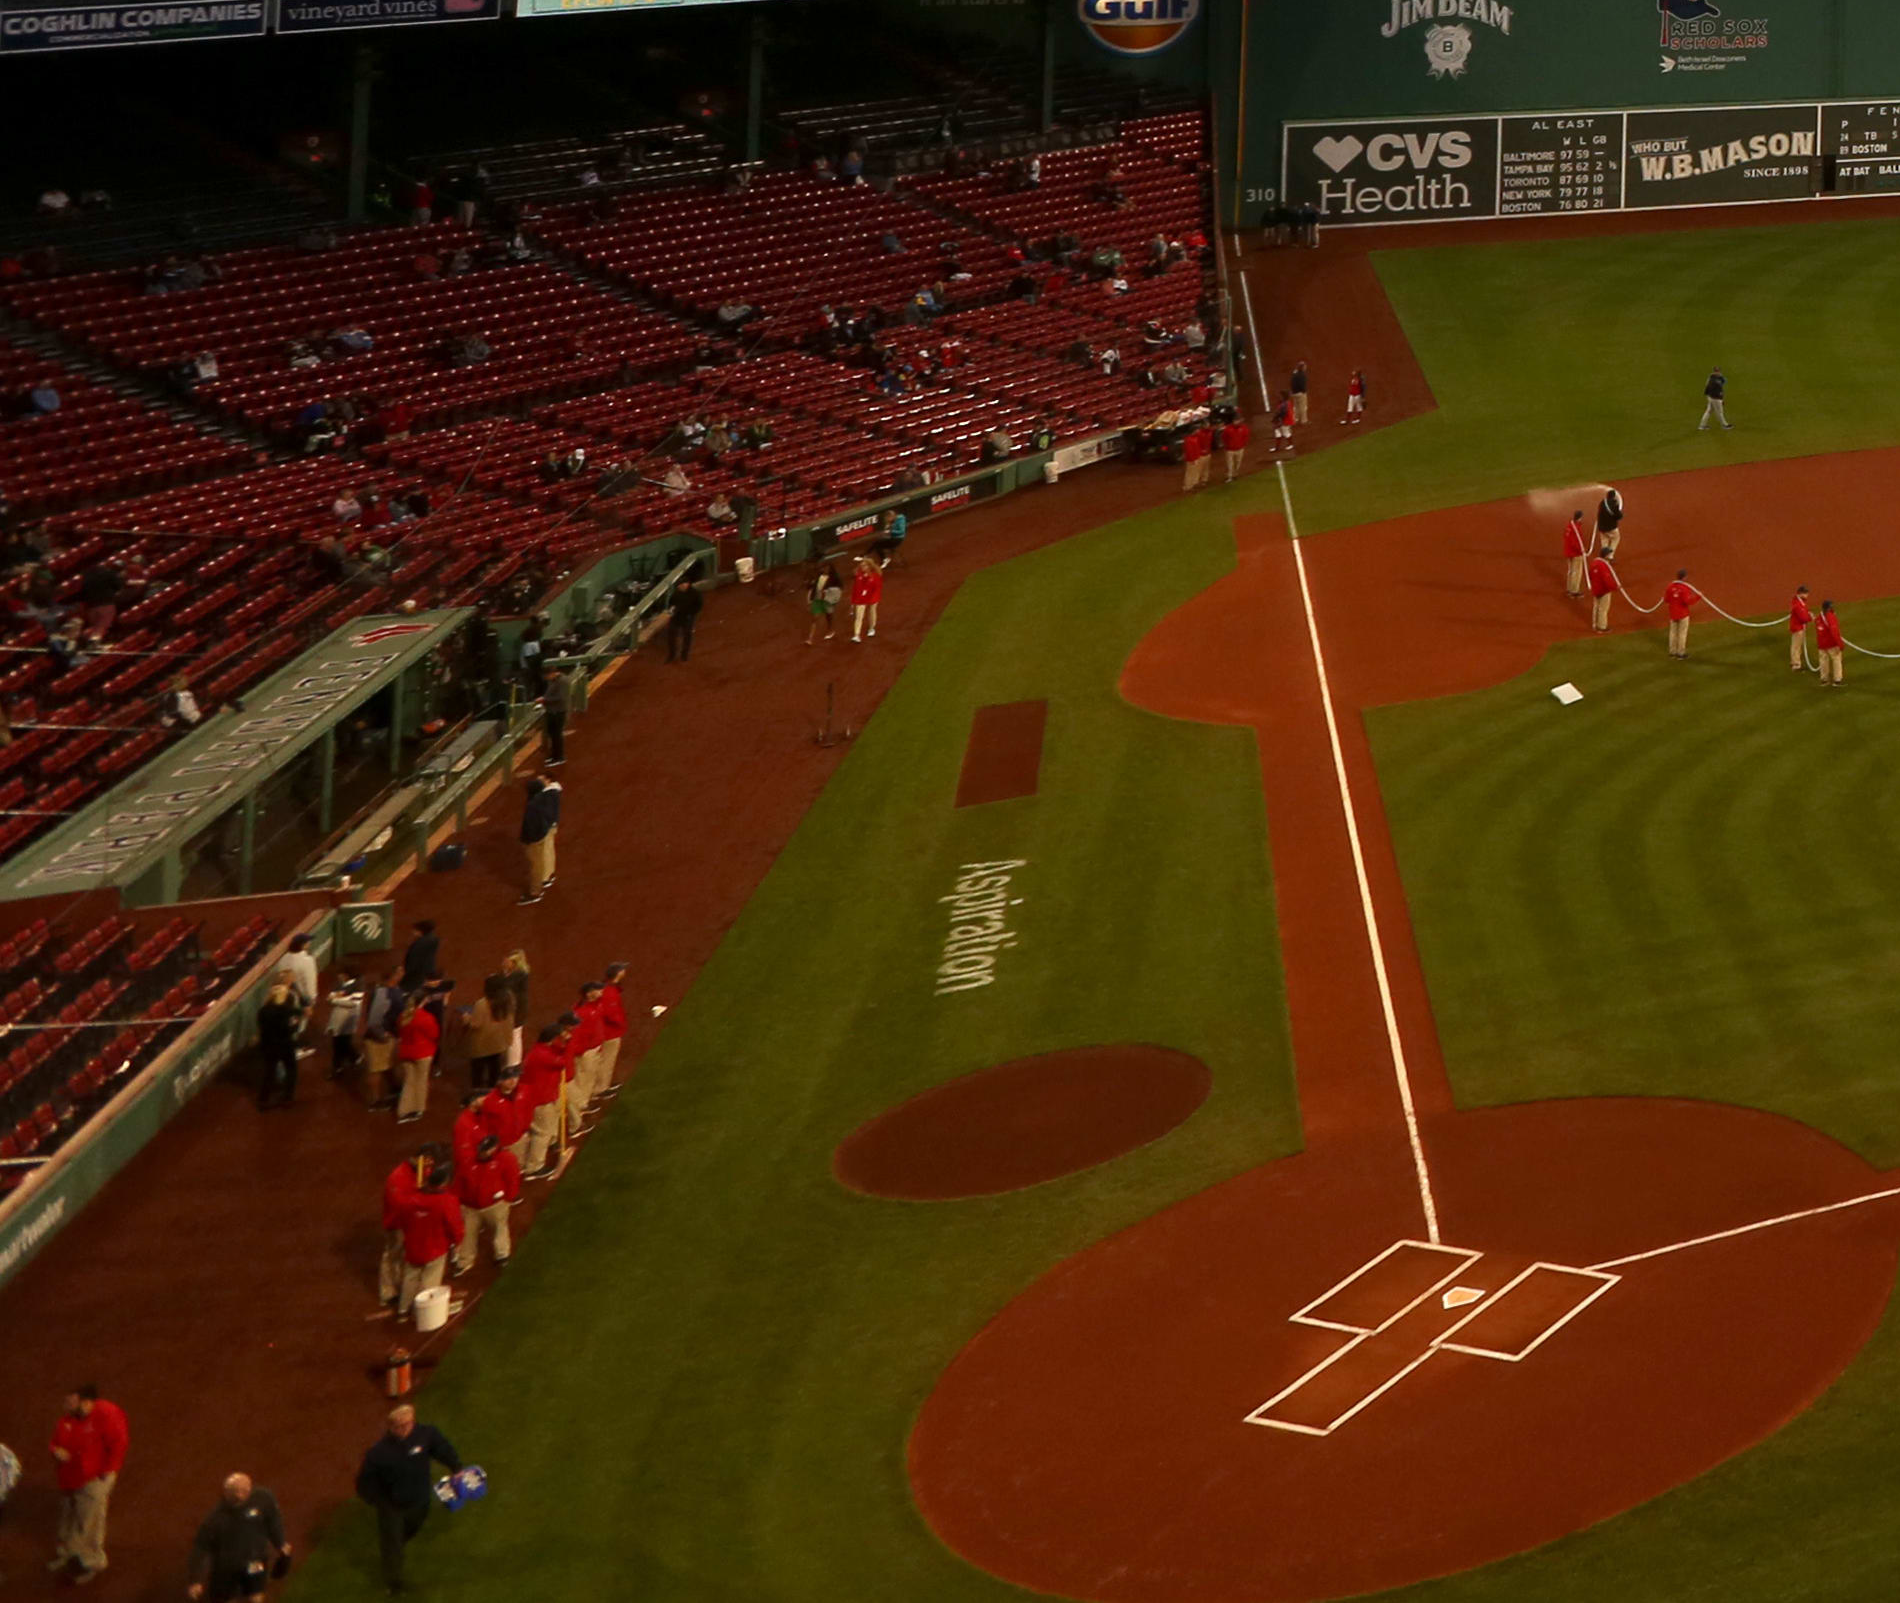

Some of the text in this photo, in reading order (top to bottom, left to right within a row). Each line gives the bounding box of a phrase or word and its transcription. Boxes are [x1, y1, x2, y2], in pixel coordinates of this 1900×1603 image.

[288, 0, 381, 24] vineyard
[3, 2, 263, 36] COGHLIN COMPANIES
[1671, 18, 1769, 36] RED SOX
[1443, 41, 1454, 53] B
[1670, 35, 1769, 50] SCHOLARS
[1557, 118, 1595, 129] EAST
[1366, 130, 1472, 173] CVS
[1632, 140, 1689, 155] WHO BUT
[1852, 144, 1888, 154] BOSTON
[1503, 151, 1555, 163] BALTIMORE
[1503, 163, 1555, 175] TAMPA BAY
[1744, 165, 1809, 178] SINCE 1898
[1853, 166, 1871, 176] BAT
[1503, 177, 1550, 188] TORONTO
[1246, 188, 1275, 203] 310
[1318, 174, 1471, 216] Health
[1502, 189, 1552, 201] NEW YORK
[1501, 202, 1542, 213] BOSTON
[934, 858, 1027, 997] Aspiration
